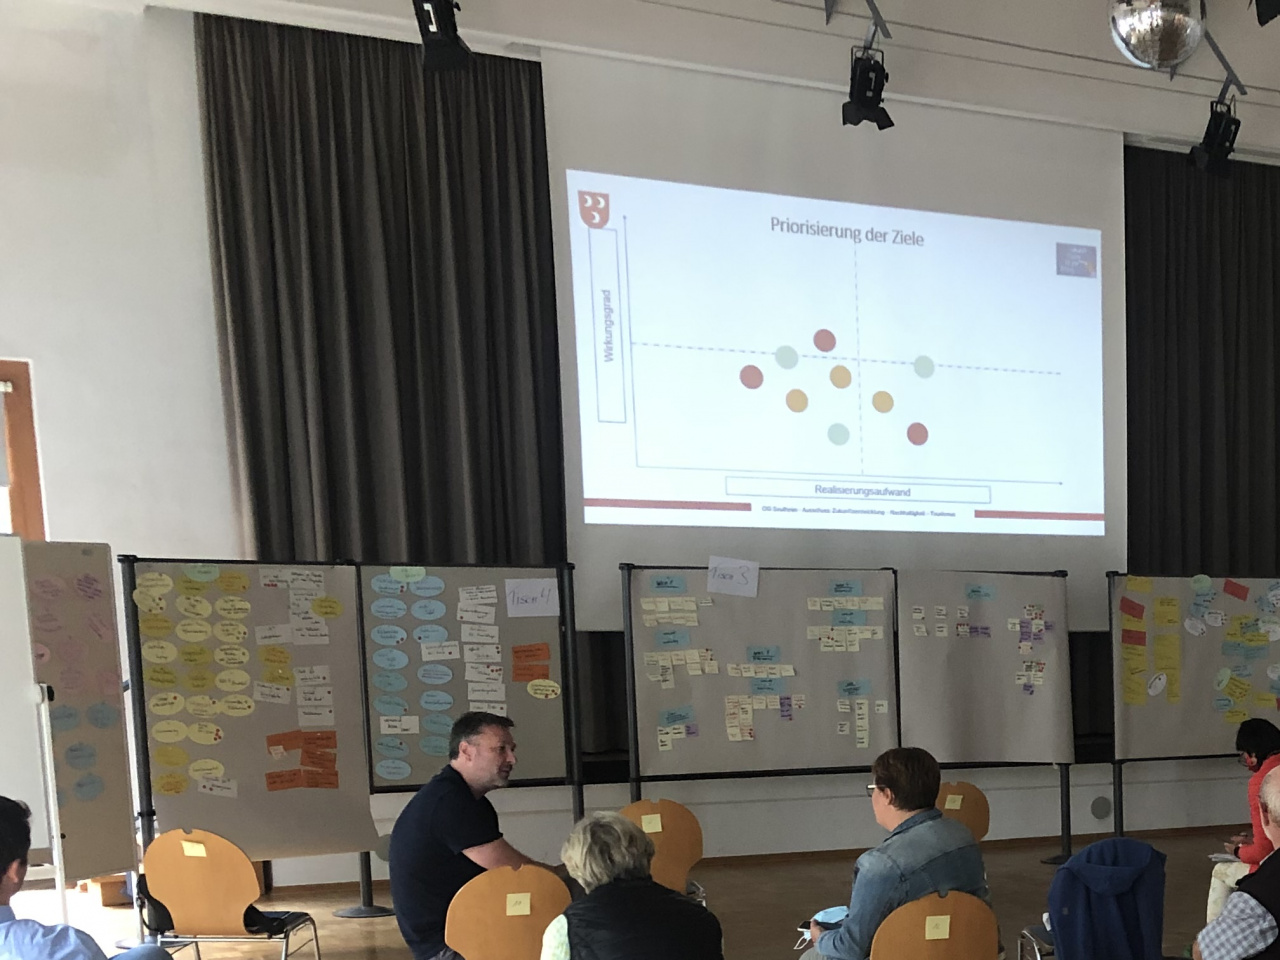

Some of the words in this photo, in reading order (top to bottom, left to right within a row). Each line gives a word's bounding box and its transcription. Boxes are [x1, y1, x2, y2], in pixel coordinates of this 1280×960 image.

[771, 216, 862, 244] Priorisierung
[865, 227, 888, 243] der
[892, 229, 925, 247] Ziele
[601, 289, 615, 362] Wirkungsgrad
[814, 484, 911, 497] Realisierungsaufwand
